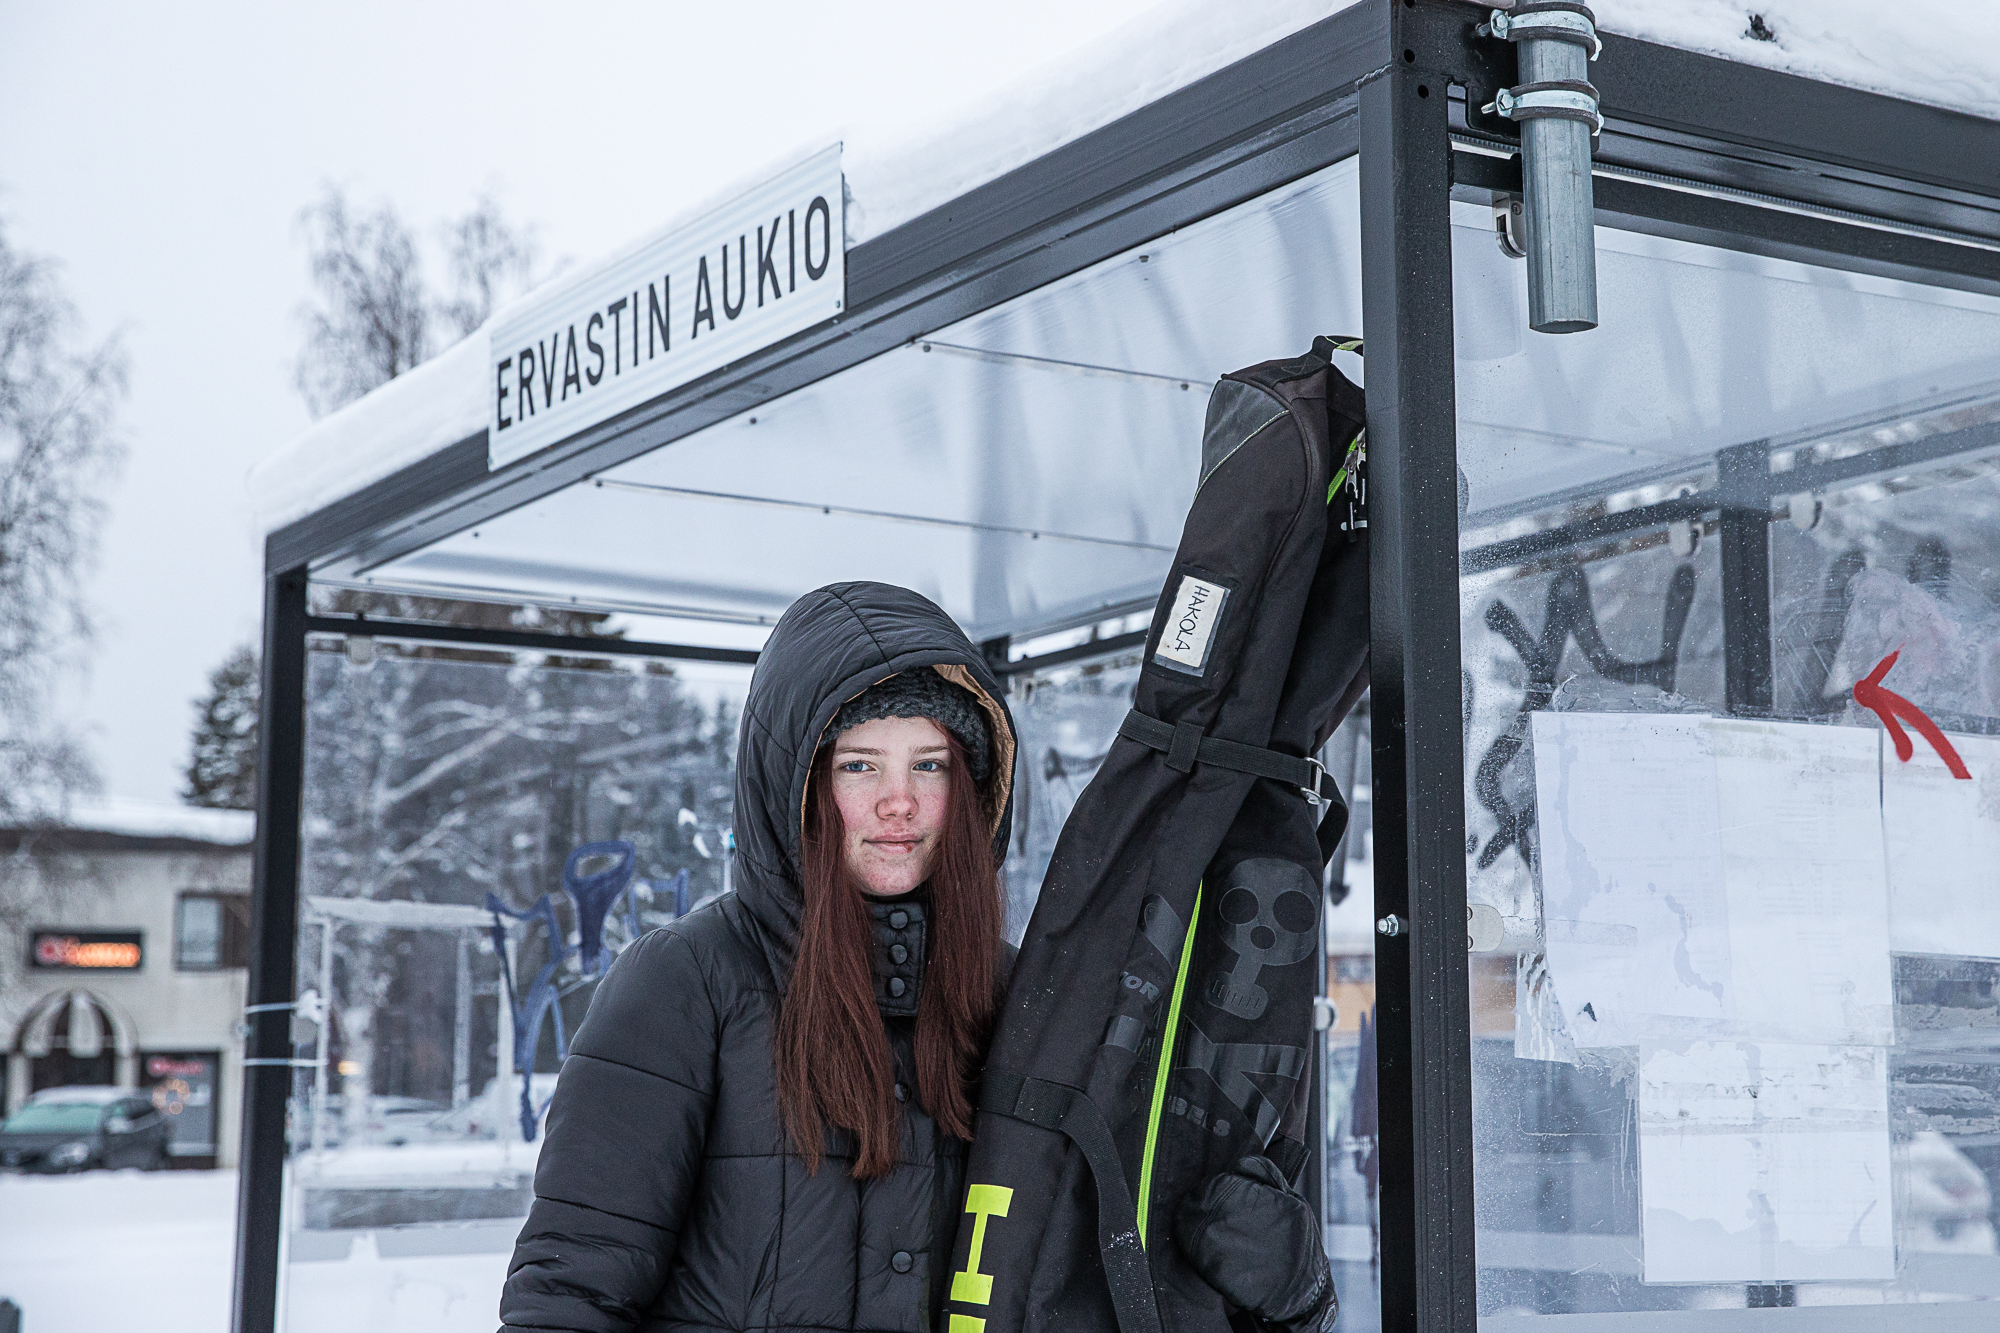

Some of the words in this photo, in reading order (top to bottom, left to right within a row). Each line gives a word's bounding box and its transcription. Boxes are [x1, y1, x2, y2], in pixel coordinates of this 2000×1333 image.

[497, 274, 670, 432] ERVASTIN
[692, 196, 831, 340] AUKIO
[1175, 585, 1211, 652] HAKOLA
